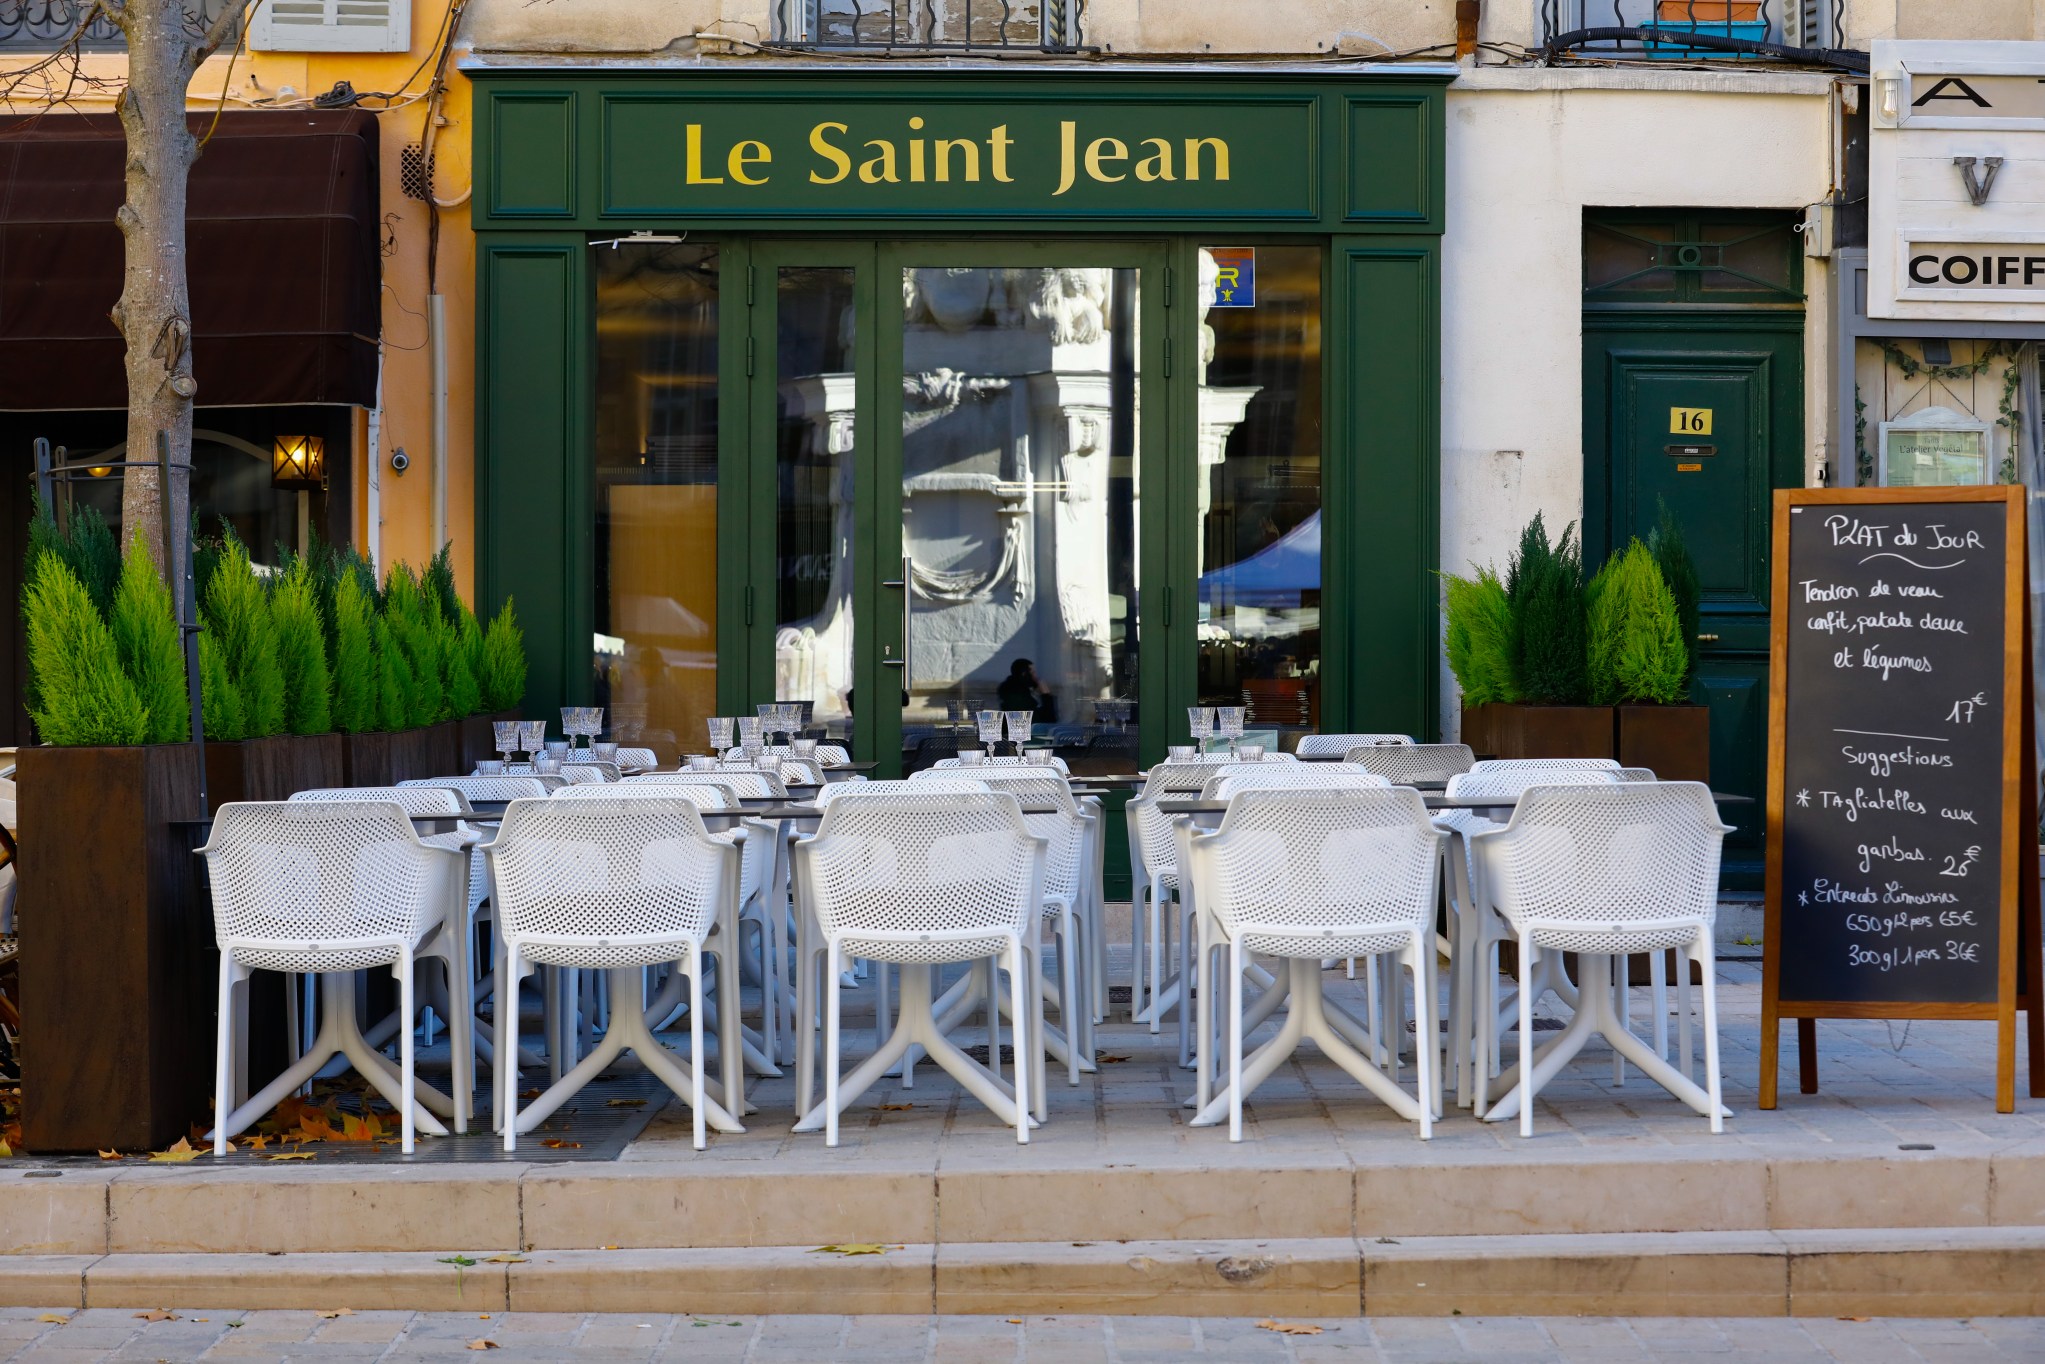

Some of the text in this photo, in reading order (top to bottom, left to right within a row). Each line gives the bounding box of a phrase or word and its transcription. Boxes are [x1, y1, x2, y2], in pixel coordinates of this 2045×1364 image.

[686, 116, 1230, 195] Le Saint Jean
[1954, 156, 2003, 205] V
[1679, 411, 1704, 431] 16
[1899, 445, 1930, 453] L'atelier
[1824, 515, 1889, 547] PLAT
[1894, 523, 1917, 546] du
[1799, 579, 1944, 603] Tendron de veau
[1920, 613, 1968, 634] douce
[1834, 644, 1932, 681] et légumes
[1842, 746, 1953, 777] Suggestions
[1941, 807, 1978, 824] aux
